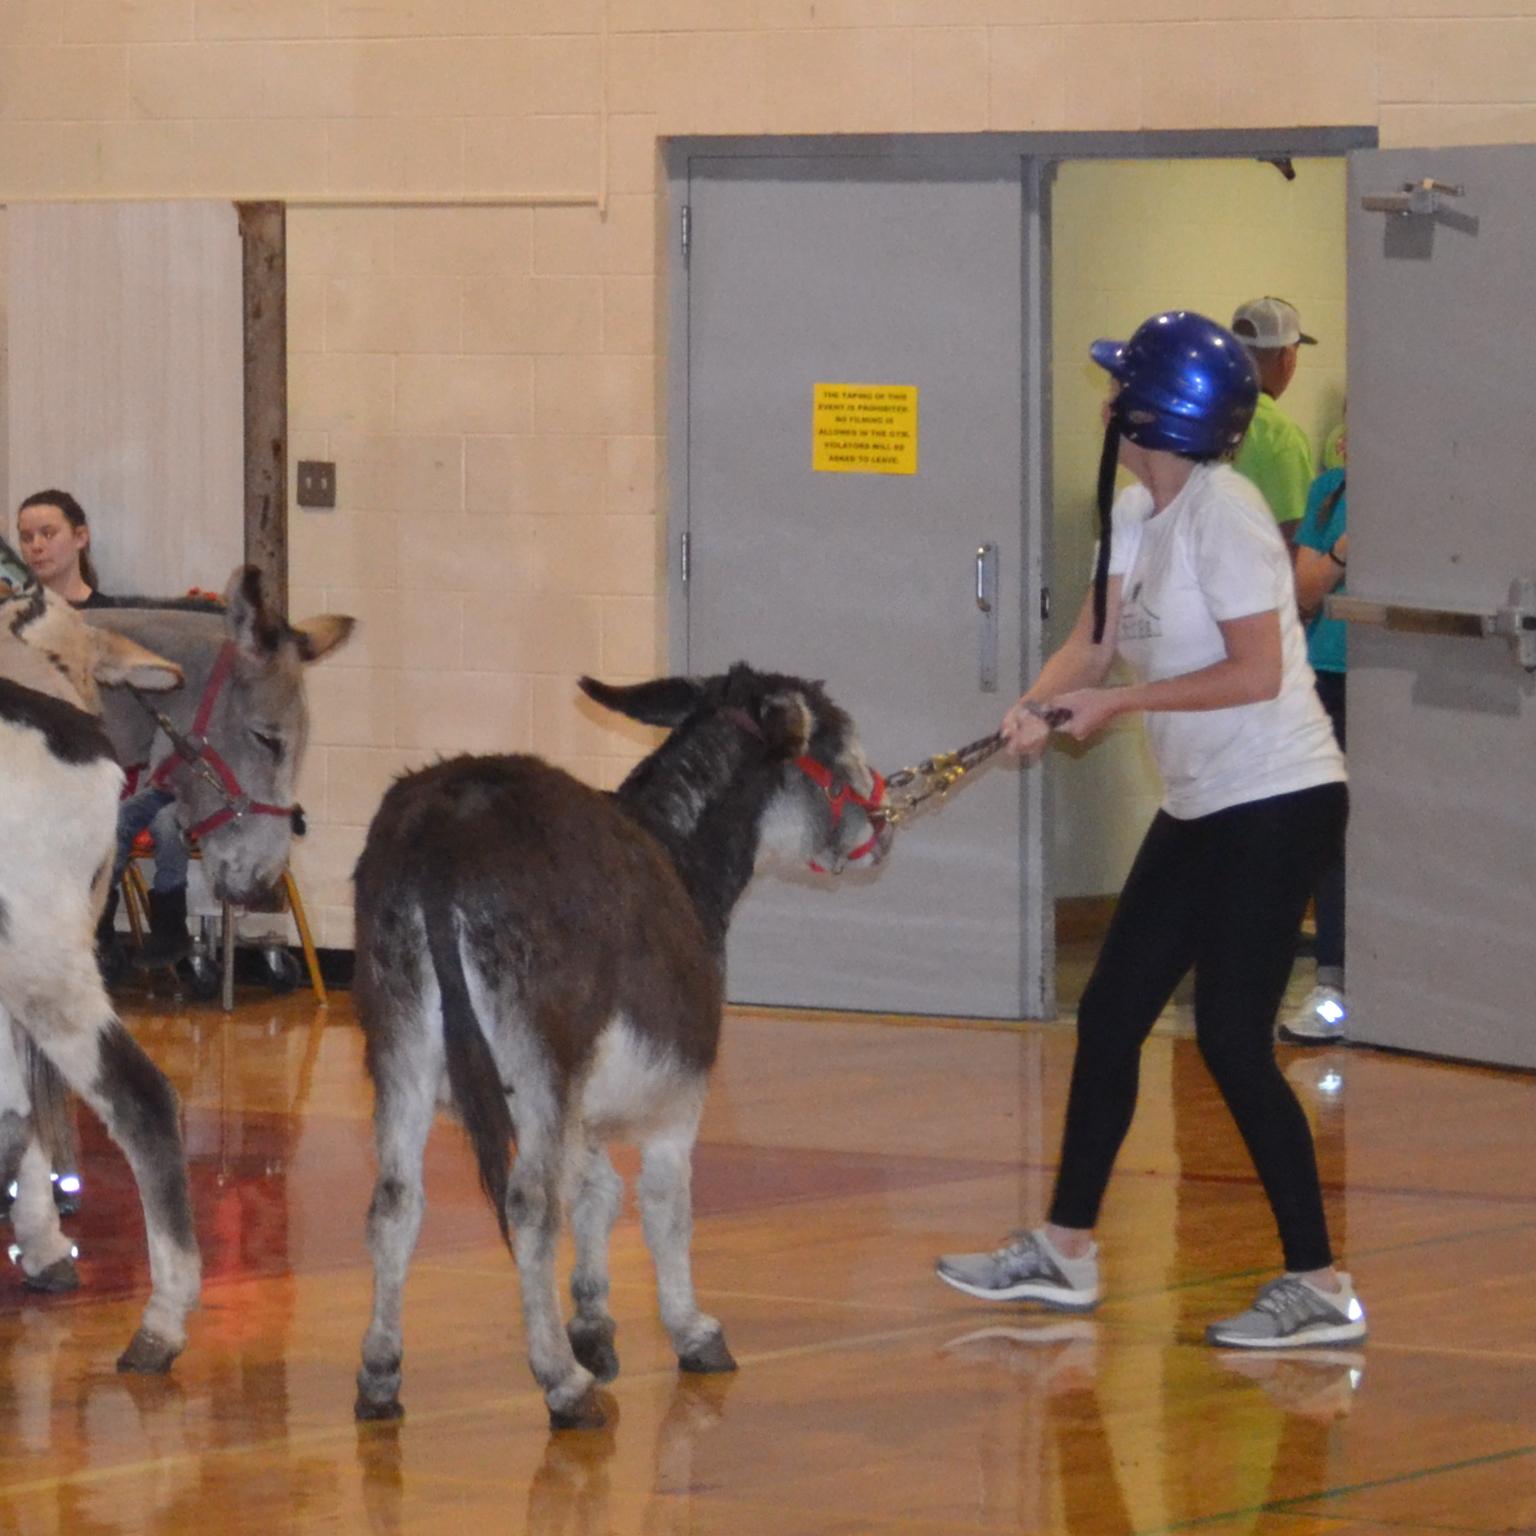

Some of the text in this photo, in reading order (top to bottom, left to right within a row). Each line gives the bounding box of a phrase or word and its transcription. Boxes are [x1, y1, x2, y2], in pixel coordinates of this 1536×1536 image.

[849, 416, 883, 424] FILMING
[818, 428, 857, 436] ALLOWED
[824, 442, 870, 450] VIOLATORS
